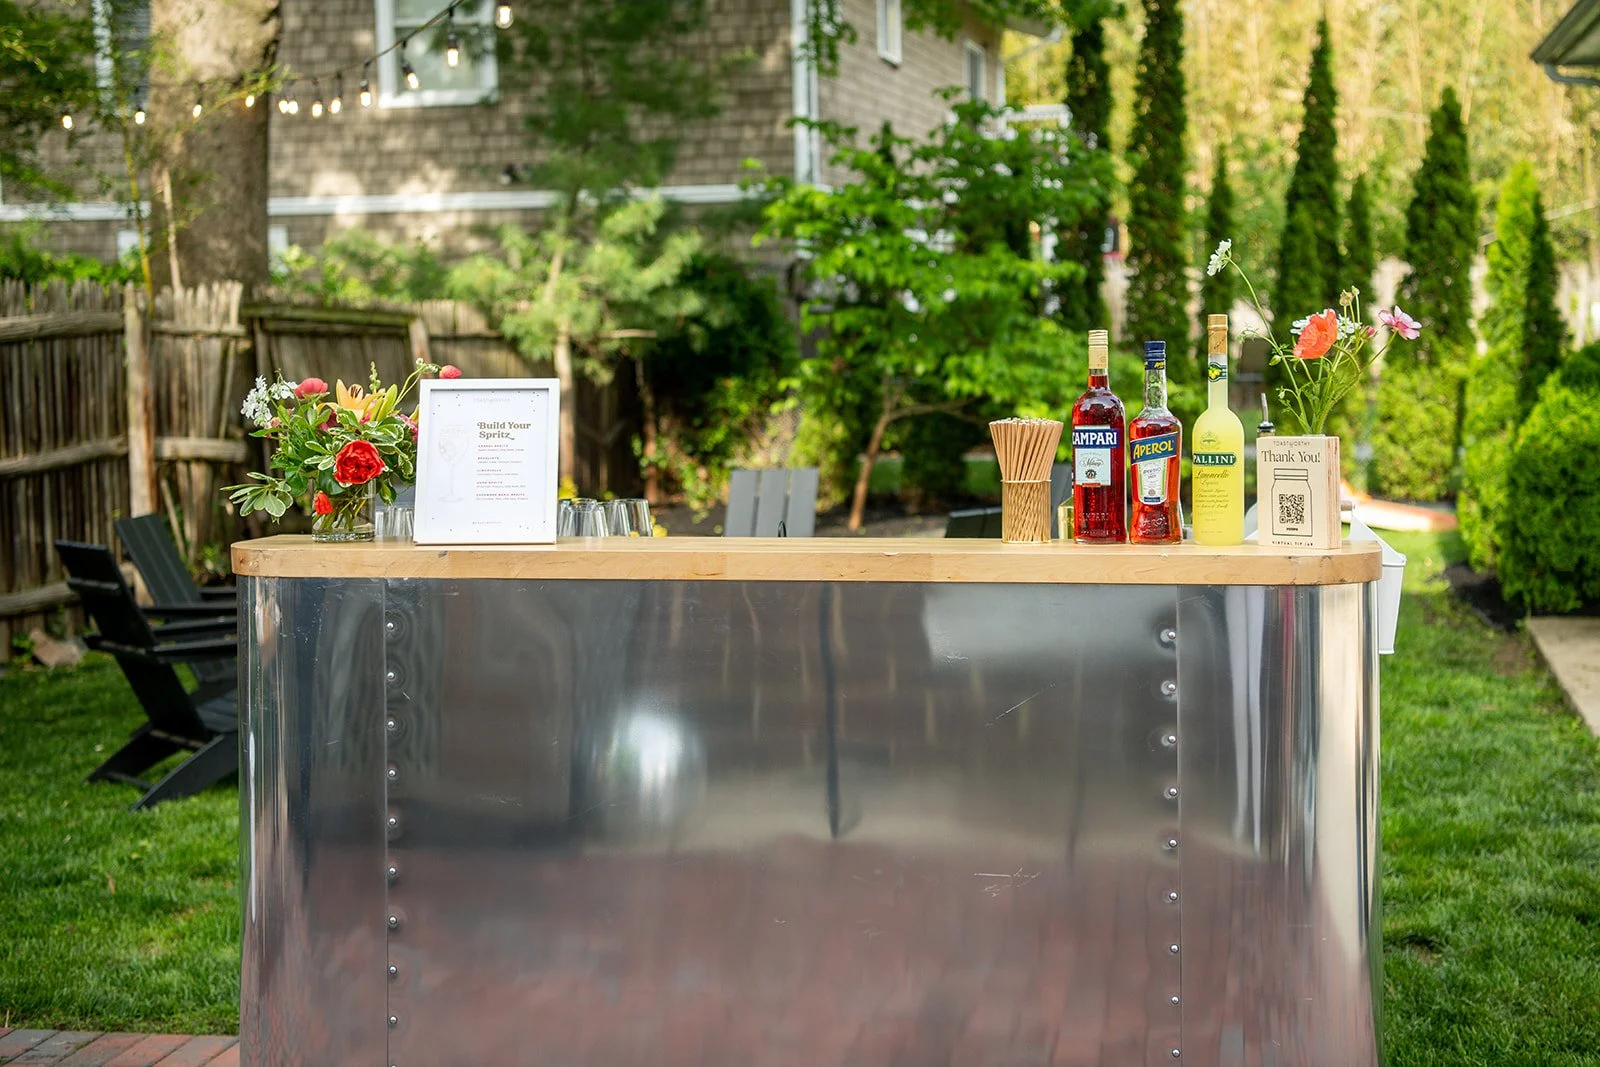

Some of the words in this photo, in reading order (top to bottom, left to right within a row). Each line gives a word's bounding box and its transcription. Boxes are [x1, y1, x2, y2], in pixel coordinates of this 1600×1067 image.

[477, 421, 506, 430] Build
[508, 421, 531, 430] Your
[479, 430, 515, 441] Spritz
[1133, 440, 1174, 460] APEROL
[1193, 455, 1234, 464] PALLINI
[1261, 449, 1295, 463] Thank
[1298, 450, 1321, 463] You!
